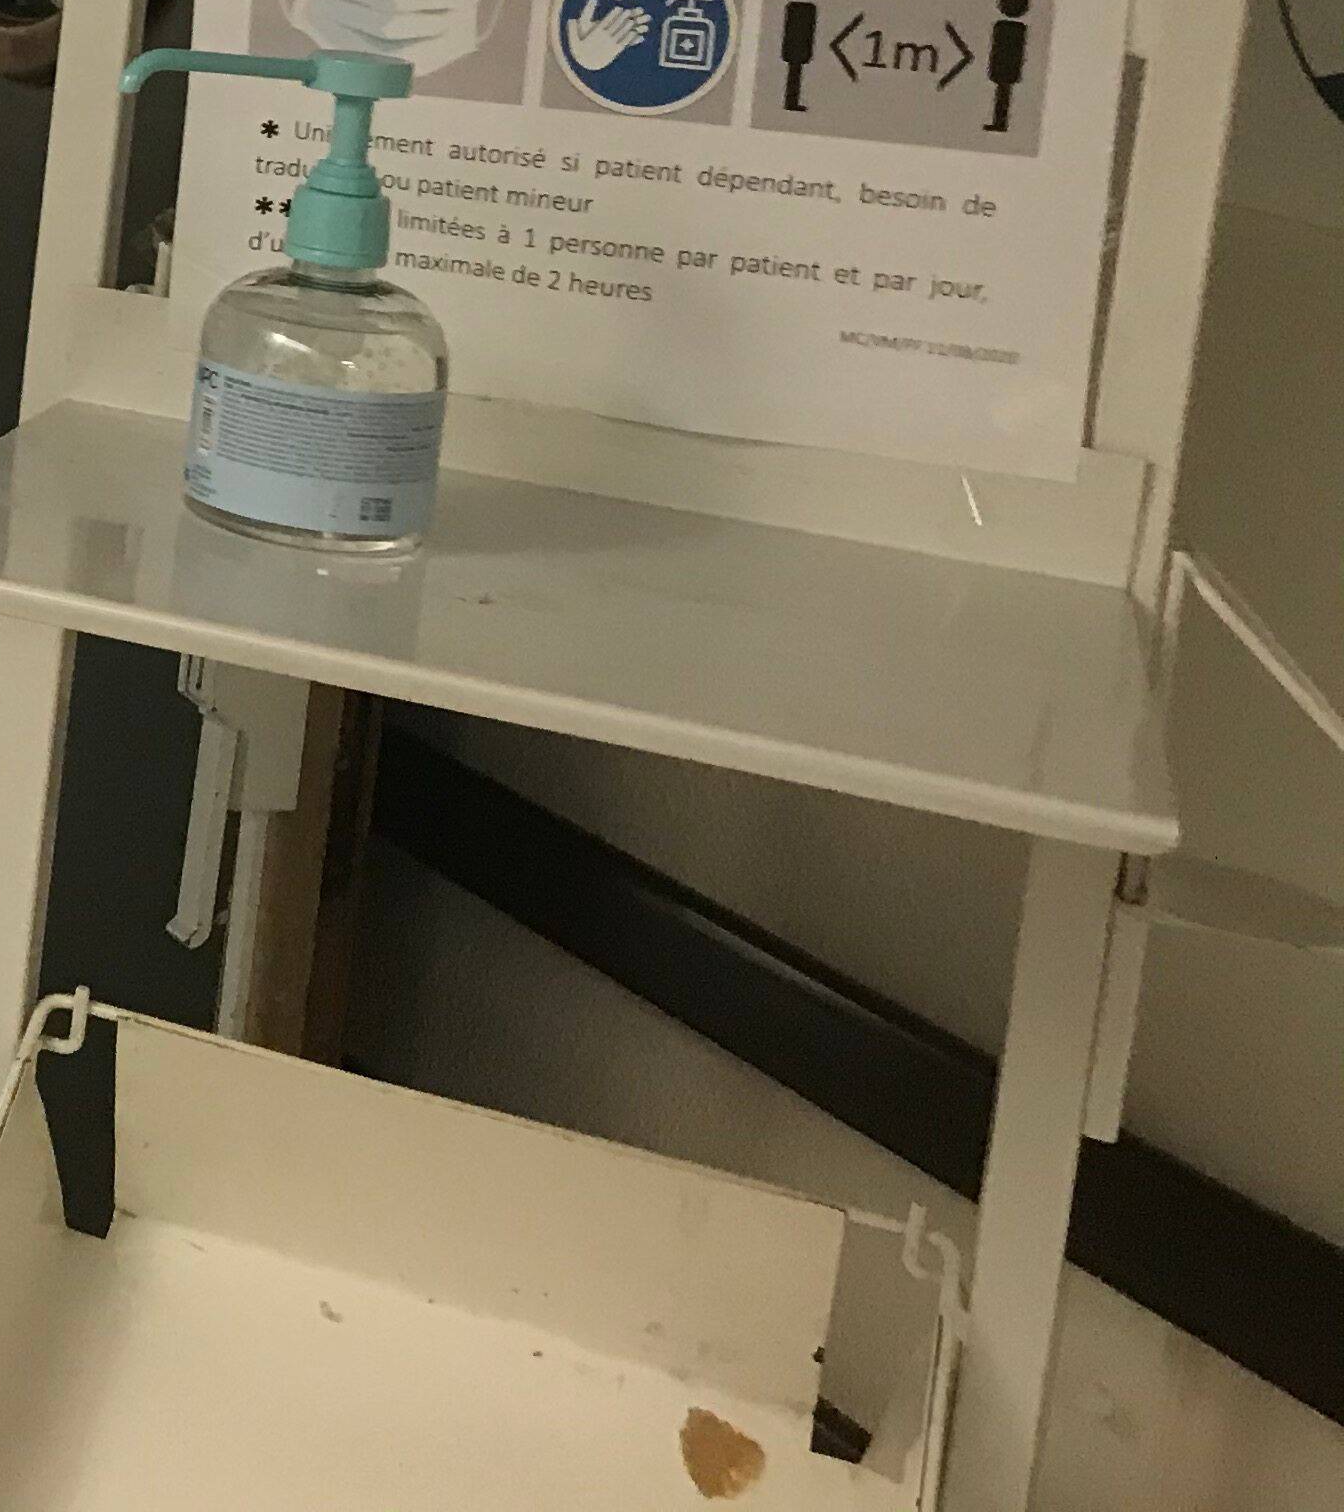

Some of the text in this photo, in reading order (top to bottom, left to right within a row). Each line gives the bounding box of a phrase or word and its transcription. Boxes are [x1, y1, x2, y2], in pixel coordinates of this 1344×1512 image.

[295, 120, 433, 157] Uniment
[448, 138, 547, 169] autorisé
[561, 151, 581, 173] si
[595, 155, 682, 184] patient
[697, 163, 842, 204] dépendant,
[859, 182, 947, 213] besoin
[961, 193, 998, 219] de
[381, 171, 410, 191] ou
[416, 176, 499, 206] patient
[506, 185, 595, 215] mineur
[395, 246, 507, 283] maximale
[511, 262, 542, 288] de
[546, 269, 562, 291] 2
[568, 273, 654, 304] heures
[397, 207, 486, 242] limitées
[497, 223, 510, 245] à
[523, 228, 536, 249] 1
[549, 231, 665, 265] personne
[678, 244, 718, 271] par
[729, 250, 821, 283] patient
[835, 262, 862, 287] et
[872, 269, 918, 295] par
